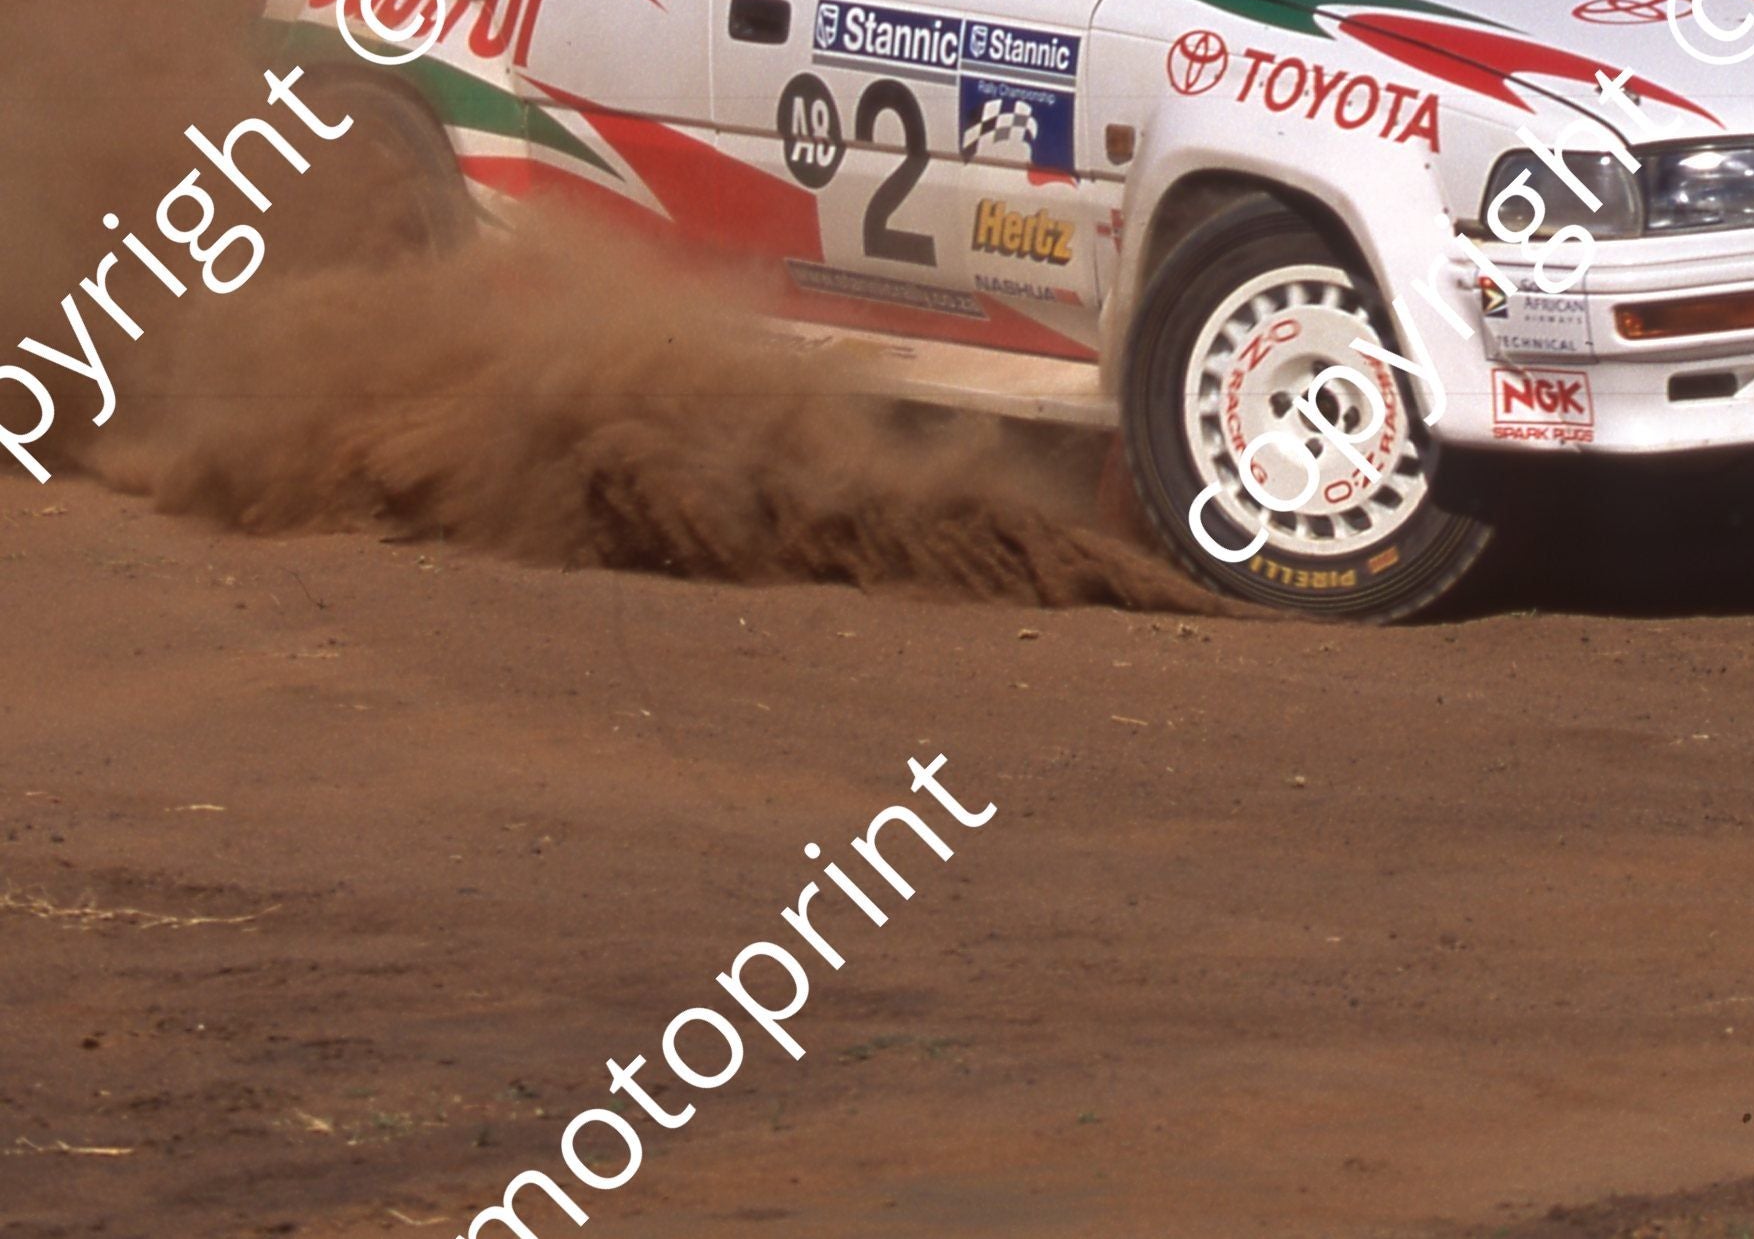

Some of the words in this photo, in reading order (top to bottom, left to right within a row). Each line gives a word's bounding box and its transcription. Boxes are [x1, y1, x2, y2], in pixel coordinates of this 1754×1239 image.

[843, 7, 959, 66] Stannic
[988, 29, 1070, 70] Stannic
[1235, 48, 1441, 153] TOYOTA
[855, 78, 938, 268] 2
[973, 198, 1077, 266] Hertz
[974, 274, 1057, 302] NASHUA
[1523, 296, 1585, 312] AFRICAN
[1502, 377, 1586, 414] NGK
[1492, 427, 1549, 440] SPARK
[1553, 428, 1594, 442] PLUGS
[1249, 554, 1358, 590] PIRELLI
